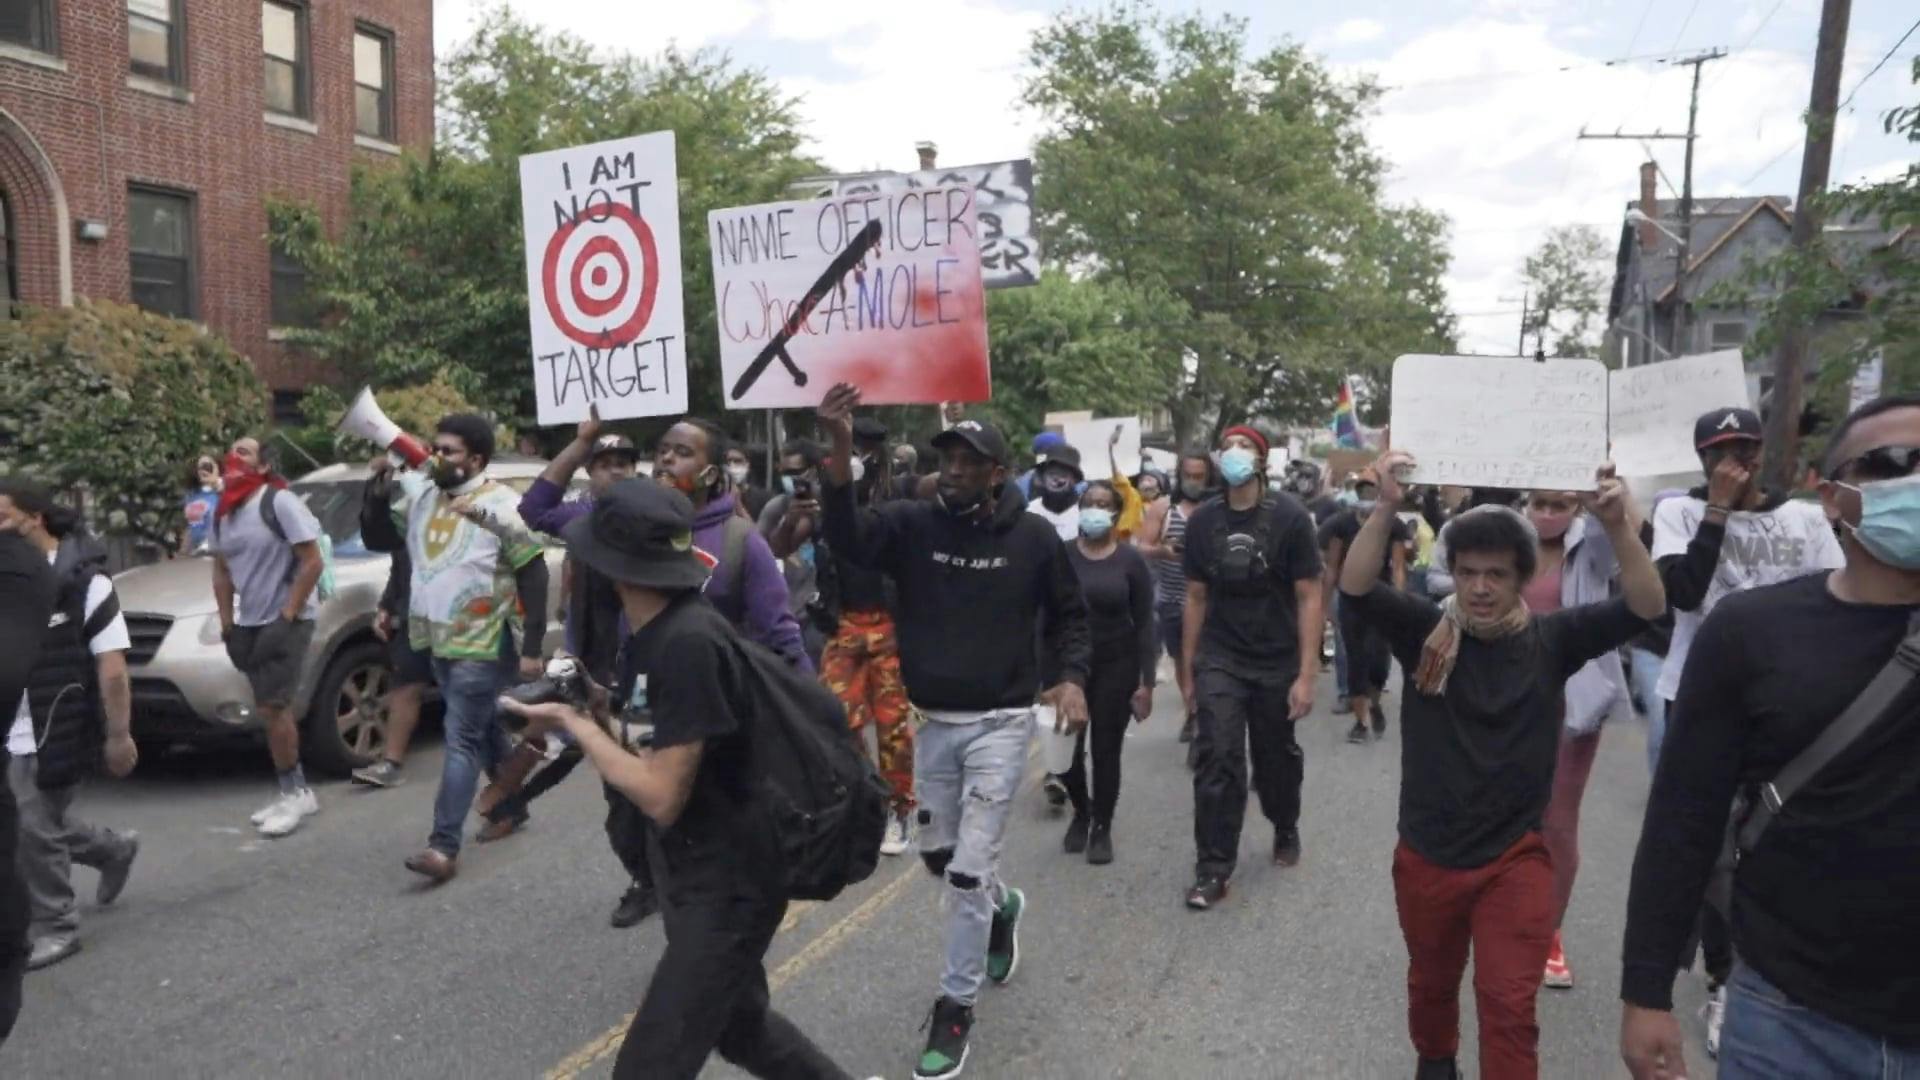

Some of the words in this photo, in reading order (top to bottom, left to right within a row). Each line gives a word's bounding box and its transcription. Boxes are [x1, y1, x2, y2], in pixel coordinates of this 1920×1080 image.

[562, 161, 571, 190] I
[589, 152, 635, 184] AM
[553, 181, 652, 231] NOT
[717, 208, 797, 267] NAME
[817, 188, 974, 256] OFFICER
[538, 335, 675, 407] TARGET
